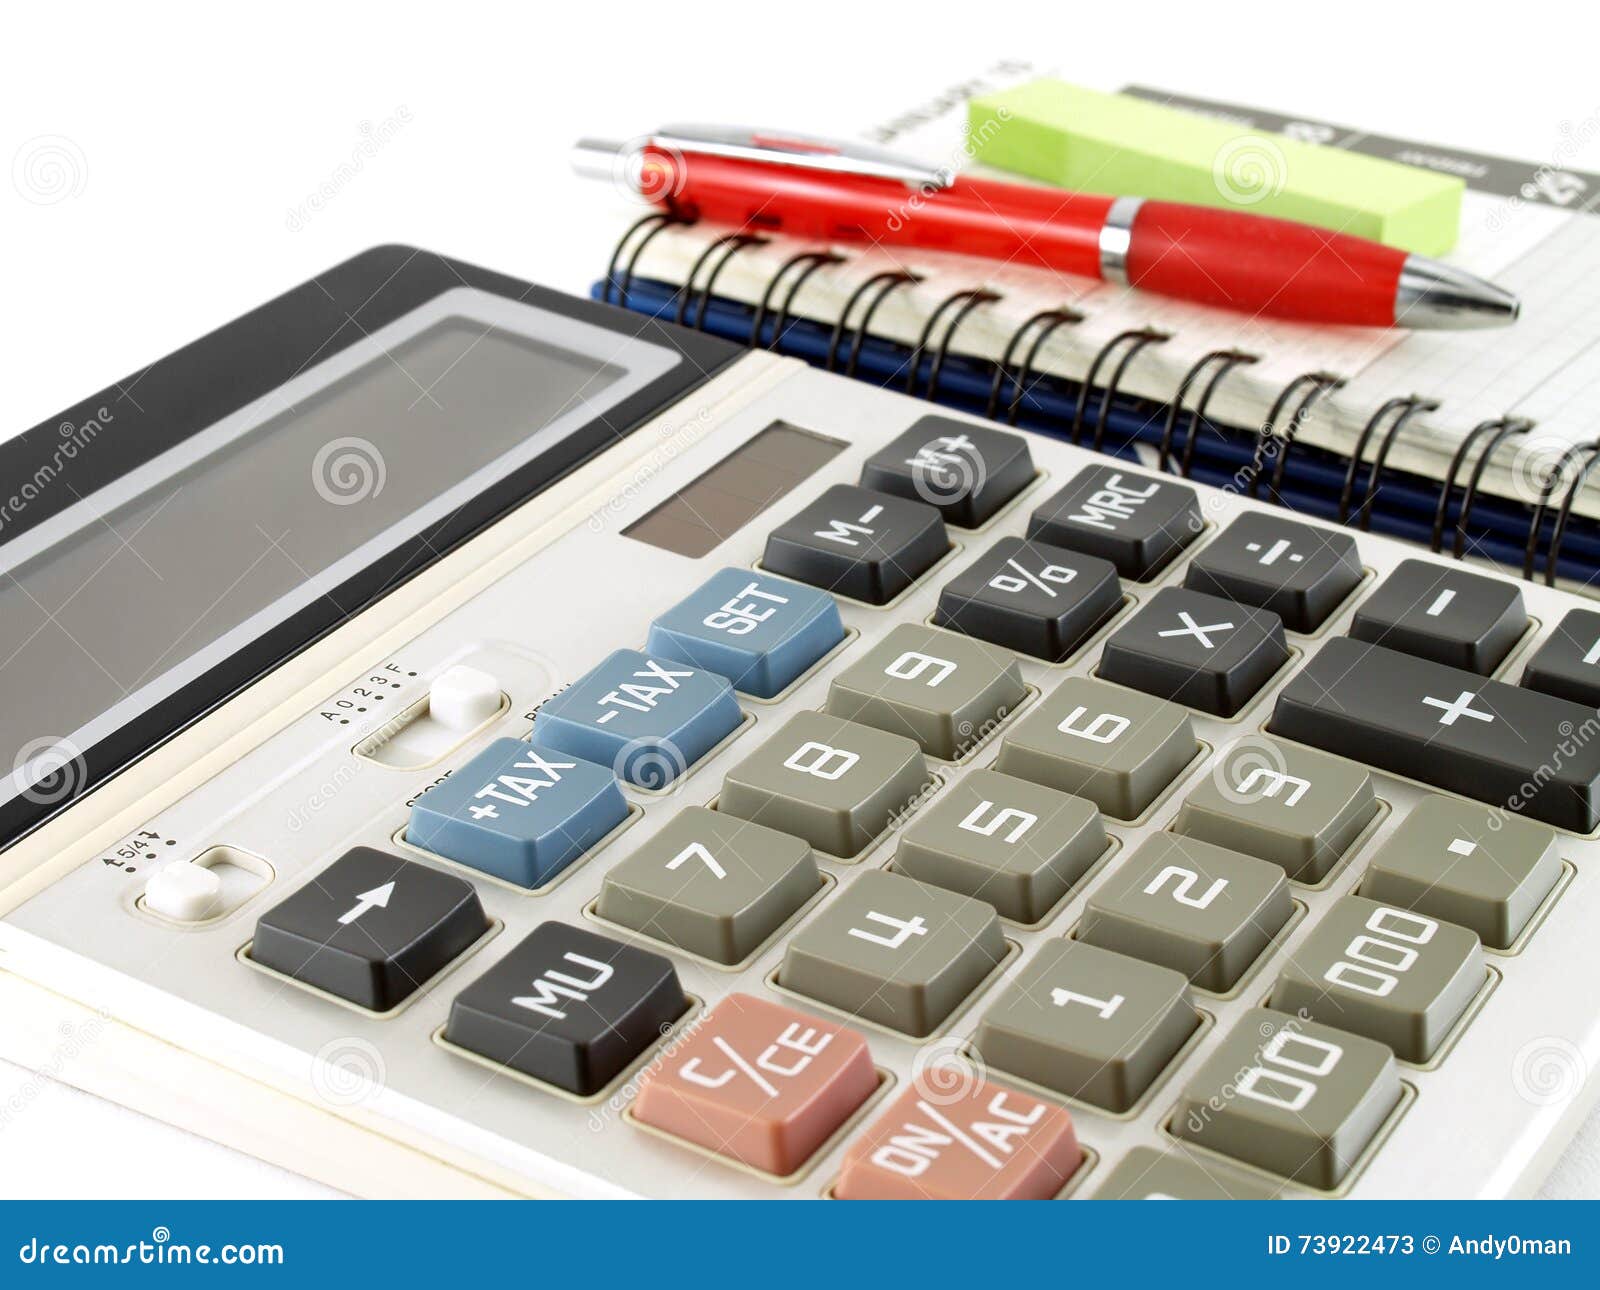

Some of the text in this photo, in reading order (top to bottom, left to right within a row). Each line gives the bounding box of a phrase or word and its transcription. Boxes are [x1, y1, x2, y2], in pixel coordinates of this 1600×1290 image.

[905, 434, 975, 473] M+
[1067, 474, 1161, 530] MRC
[814, 505, 883, 545] M-
[989, 559, 1078, 598] %
[703, 582, 789, 635] SET
[596, 659, 694, 724] -TAX
[884, 651, 958, 688] 9
[1057, 706, 1131, 744] 6
[783, 741, 860, 780] 8
[469, 750, 577, 820] +TAX
[1236, 768, 1311, 807] 3
[958, 800, 1038, 844] 5
[665, 842, 727, 880] 7
[1144, 865, 1230, 910] 2
[848, 911, 928, 949] 4
[1324, 907, 1439, 997] 000
[511, 952, 614, 1020] MU
[1050, 987, 1126, 1020] 1
[679, 1022, 835, 1098] C/CE
[1235, 1030, 1344, 1111] 00
[870, 1091, 1047, 1177] ON/AC
